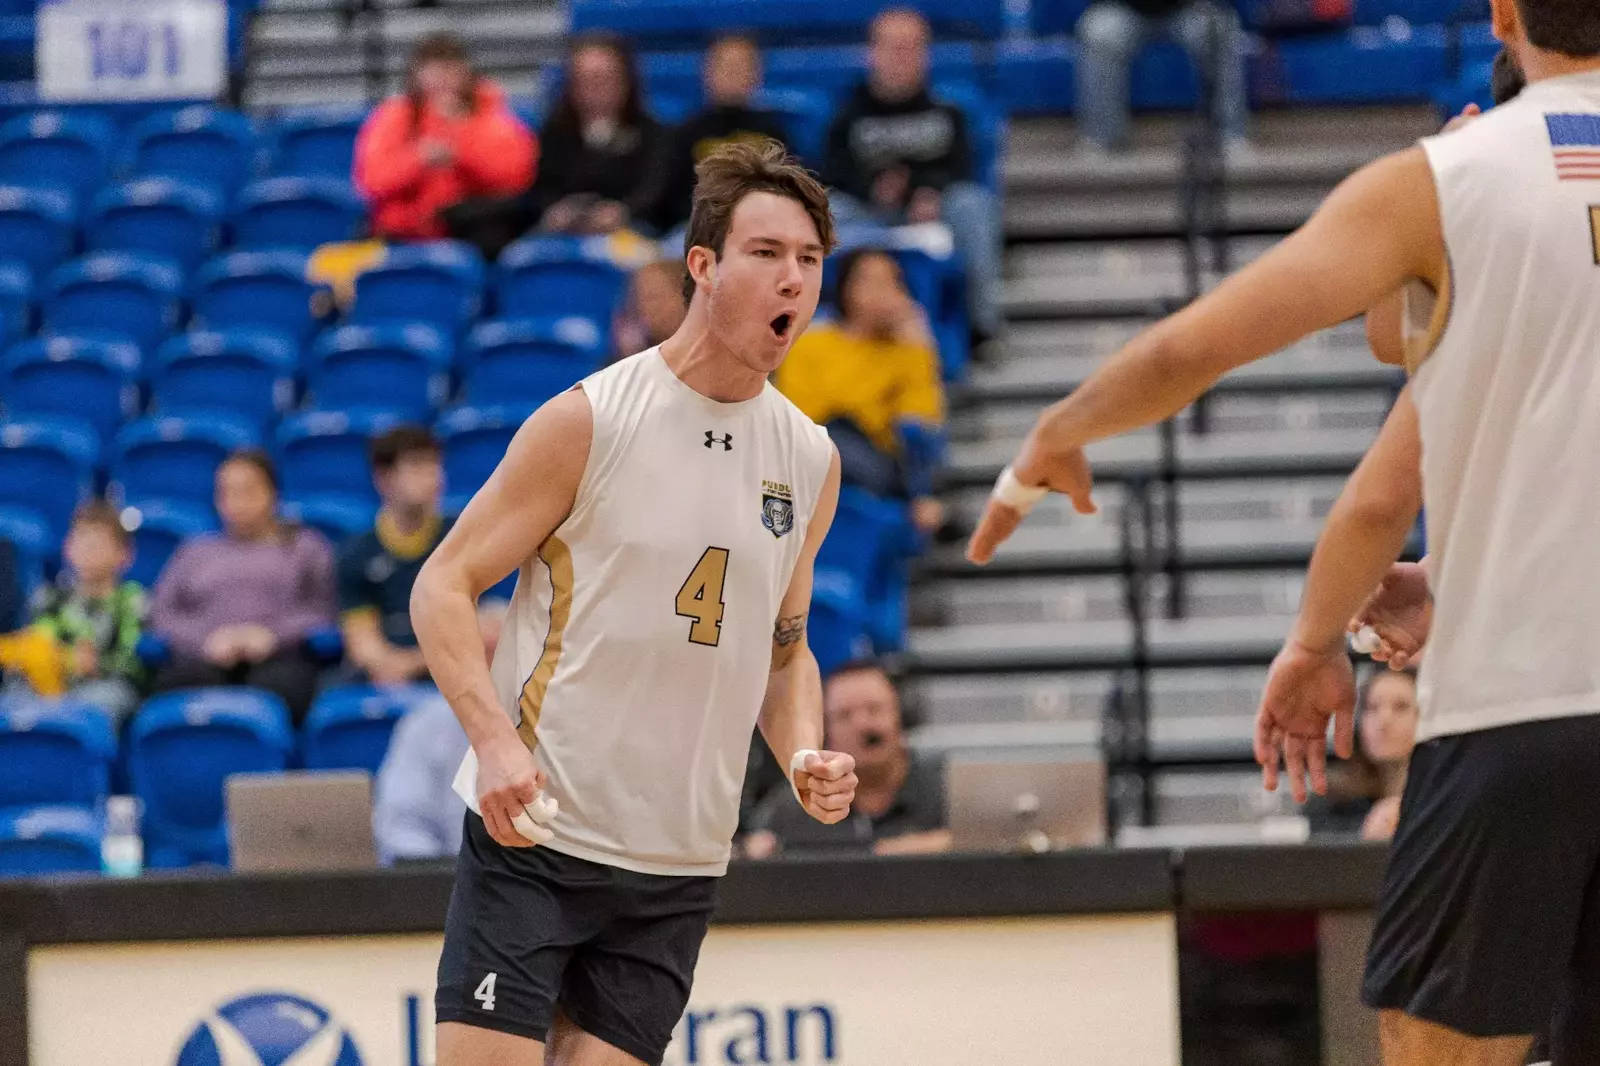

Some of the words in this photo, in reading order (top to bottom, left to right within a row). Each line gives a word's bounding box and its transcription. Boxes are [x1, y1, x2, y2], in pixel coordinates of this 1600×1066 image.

[88, 20, 180, 78] 101
[675, 545, 730, 648] 4
[473, 972, 498, 1011] 4
